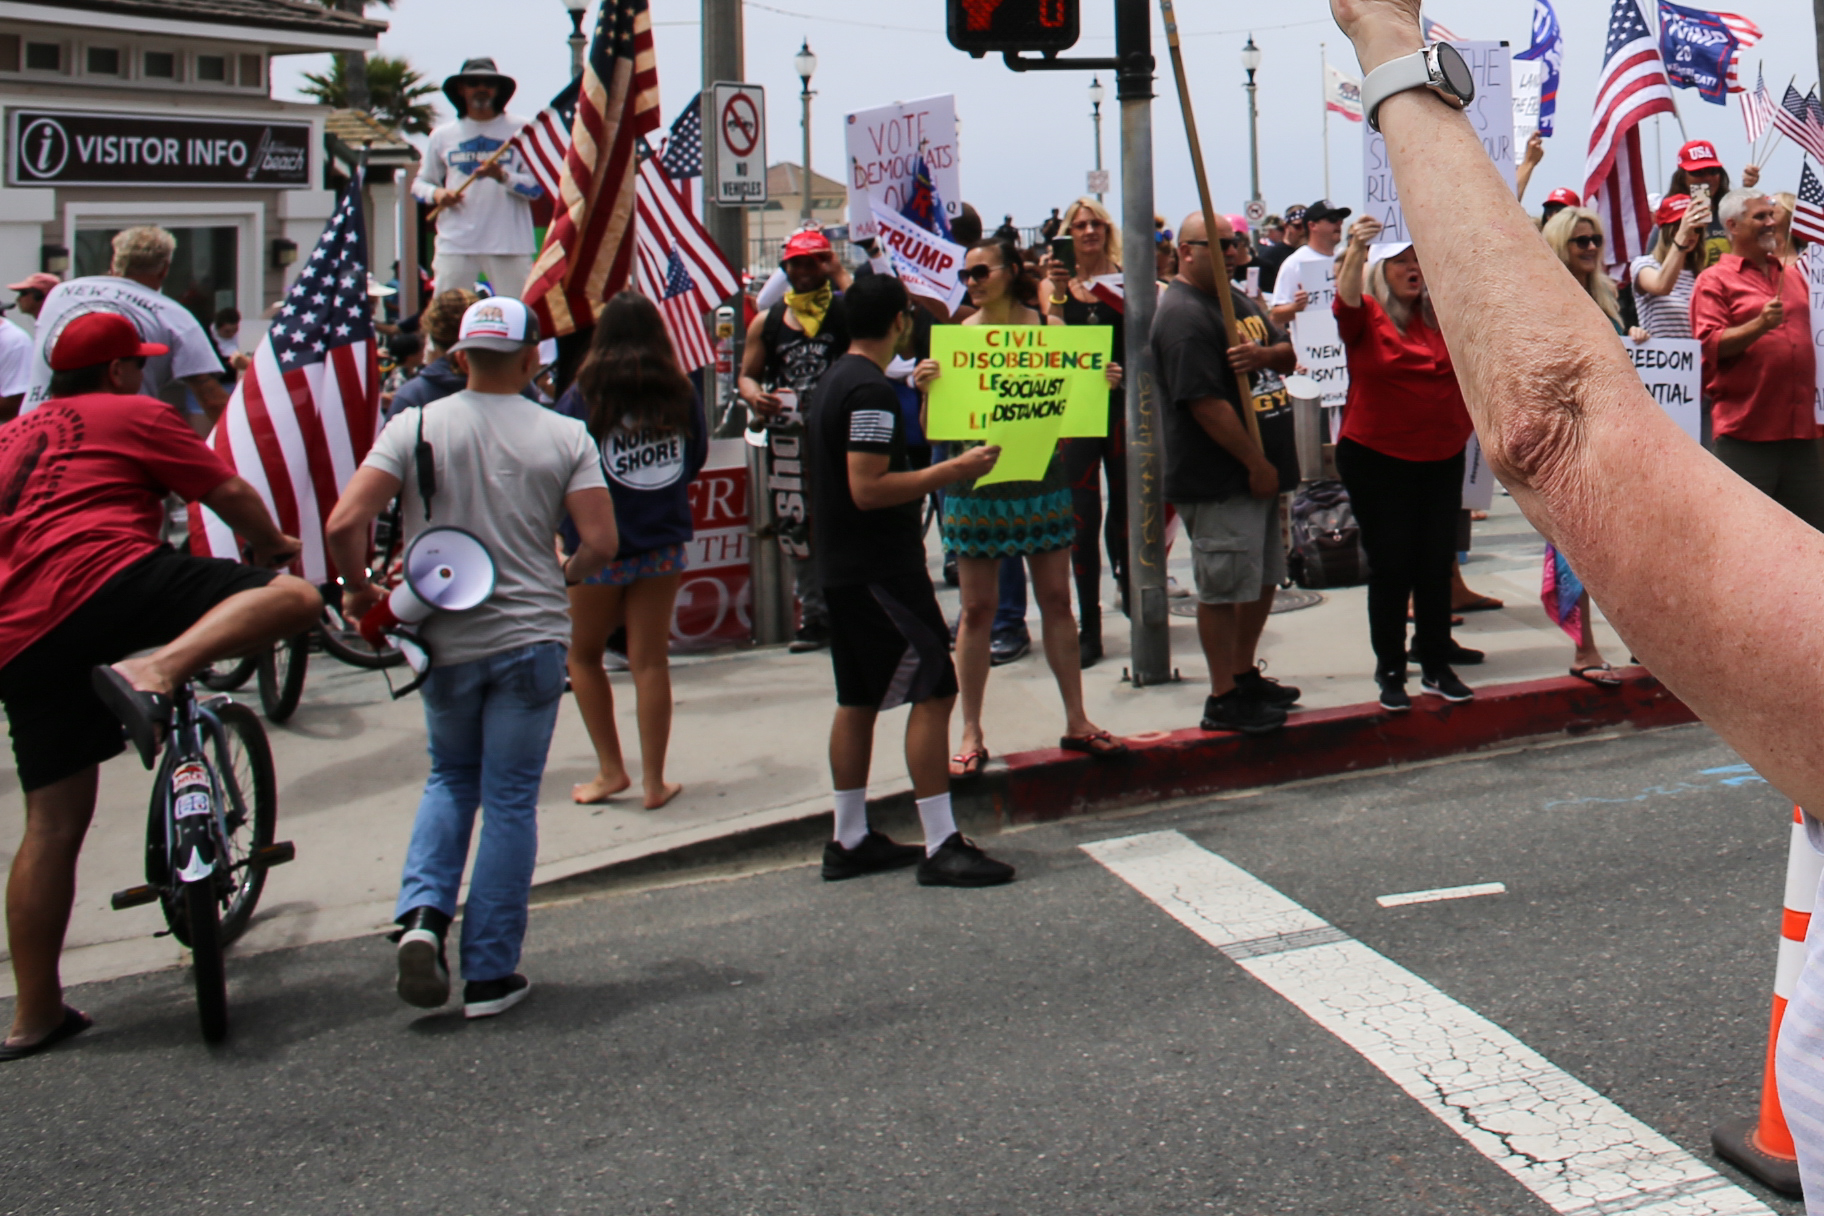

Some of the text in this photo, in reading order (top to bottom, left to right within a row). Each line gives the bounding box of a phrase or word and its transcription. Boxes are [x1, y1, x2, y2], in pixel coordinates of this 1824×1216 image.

[867, 111, 930, 157] VOTE
[76, 135, 179, 165] VISITOR
[187, 139, 248, 168] INFO
[1687, 145, 1714, 161] USA
[736, 162, 748, 177] NO
[854, 145, 953, 190] DEMOCATS
[722, 181, 762, 196] VEHICLES
[877, 221, 954, 275] TRUMP
[985, 330, 1048, 348] CIVIL
[953, 351, 1103, 370] DISOBEDIENCE
[998, 378, 1065, 398] SOCIALIST
[1645, 383, 1694, 406] NTIAL
[991, 399, 1067, 423] DISTANCING
[616, 439, 678, 475] SHORE
